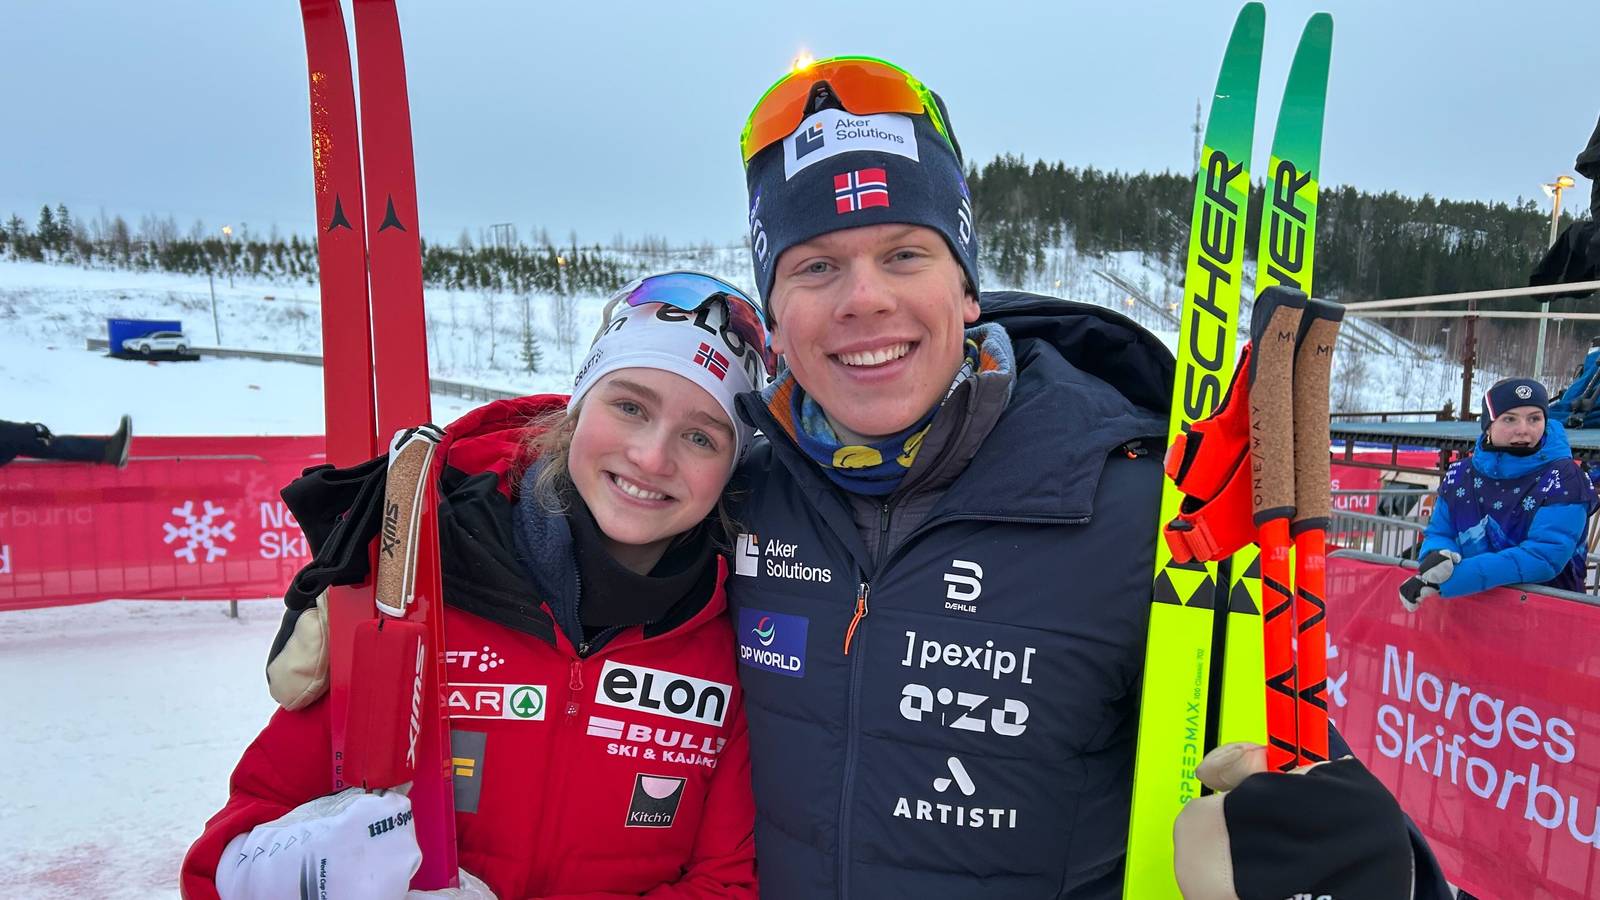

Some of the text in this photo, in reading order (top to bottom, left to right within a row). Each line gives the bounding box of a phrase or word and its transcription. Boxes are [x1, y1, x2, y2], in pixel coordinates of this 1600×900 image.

[835, 118, 871, 130] Aker
[836, 128, 905, 144] Solutions
[574, 357, 598, 388] CRAFT
[764, 538, 798, 558] Aker
[766, 559, 832, 583] Solutions
[740, 645, 801, 671] DP WORLD
[1382, 644, 1576, 764] Norges
[606, 743, 639, 758] SKI
[643, 748, 656, 761] &
[893, 797, 1017, 829] ARTISTI
[319, 878, 327, 891] Cup
